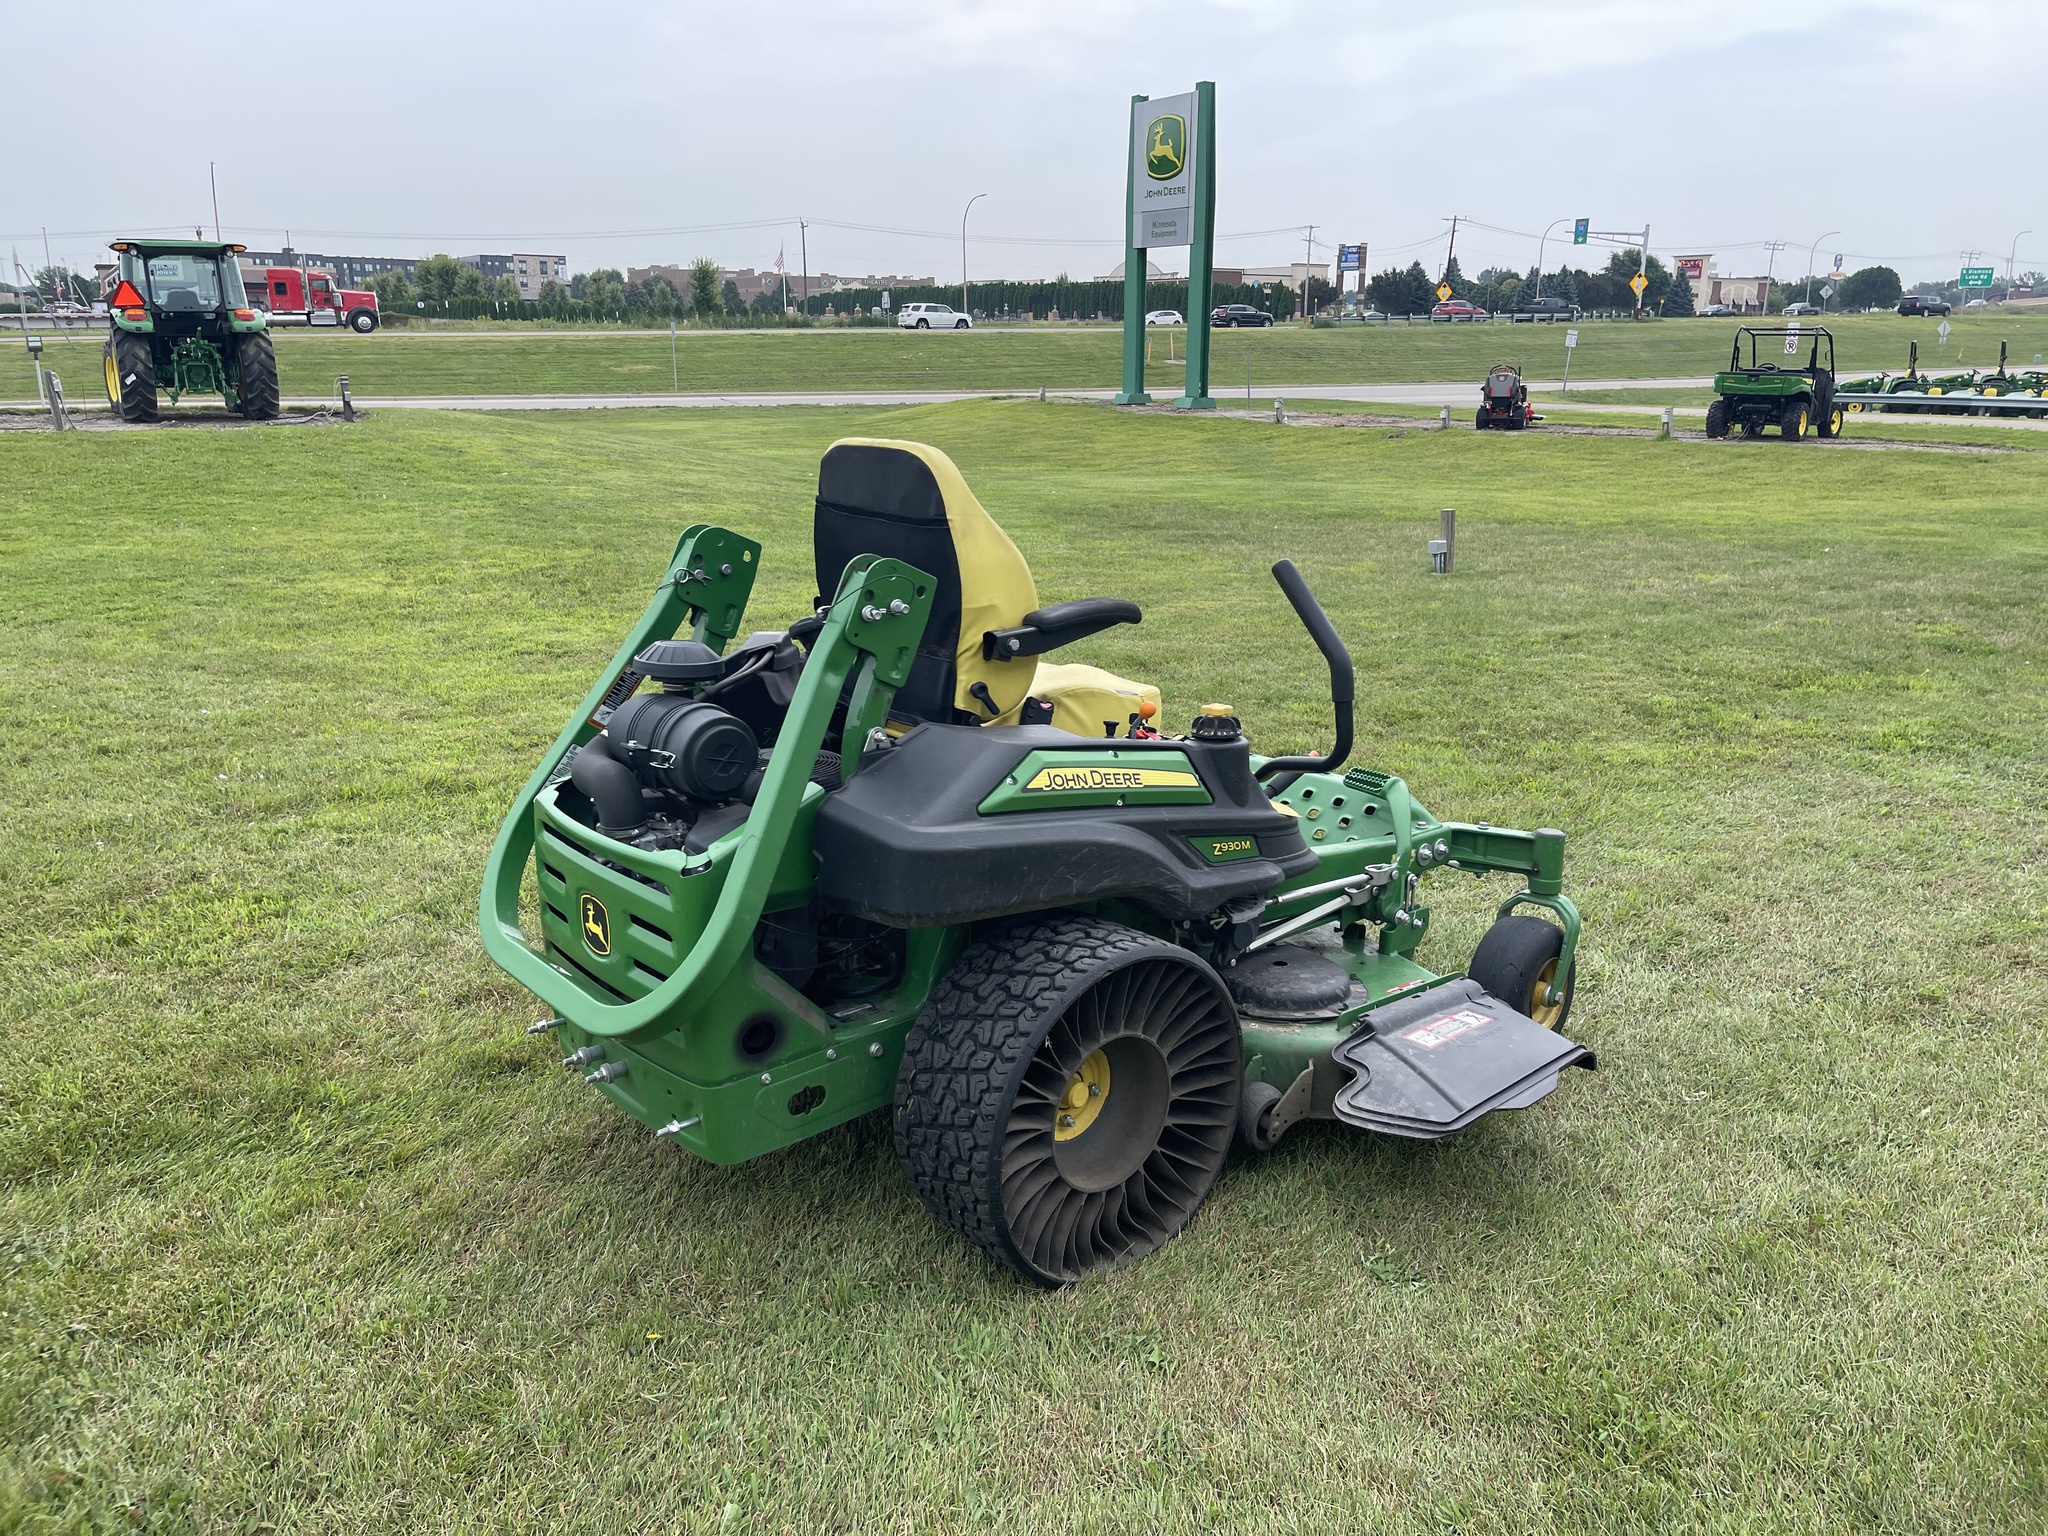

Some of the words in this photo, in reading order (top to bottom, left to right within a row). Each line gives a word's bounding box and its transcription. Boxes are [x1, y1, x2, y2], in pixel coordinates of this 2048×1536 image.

[1144, 189, 1163, 199] JOHN
[1163, 186, 1186, 196] DEERE
[1151, 220, 1177, 229] Minnesota
[1151, 229, 1177, 239] Equipment
[1044, 771, 1088, 788] JOHN
[1089, 770, 1143, 787] DEERE
